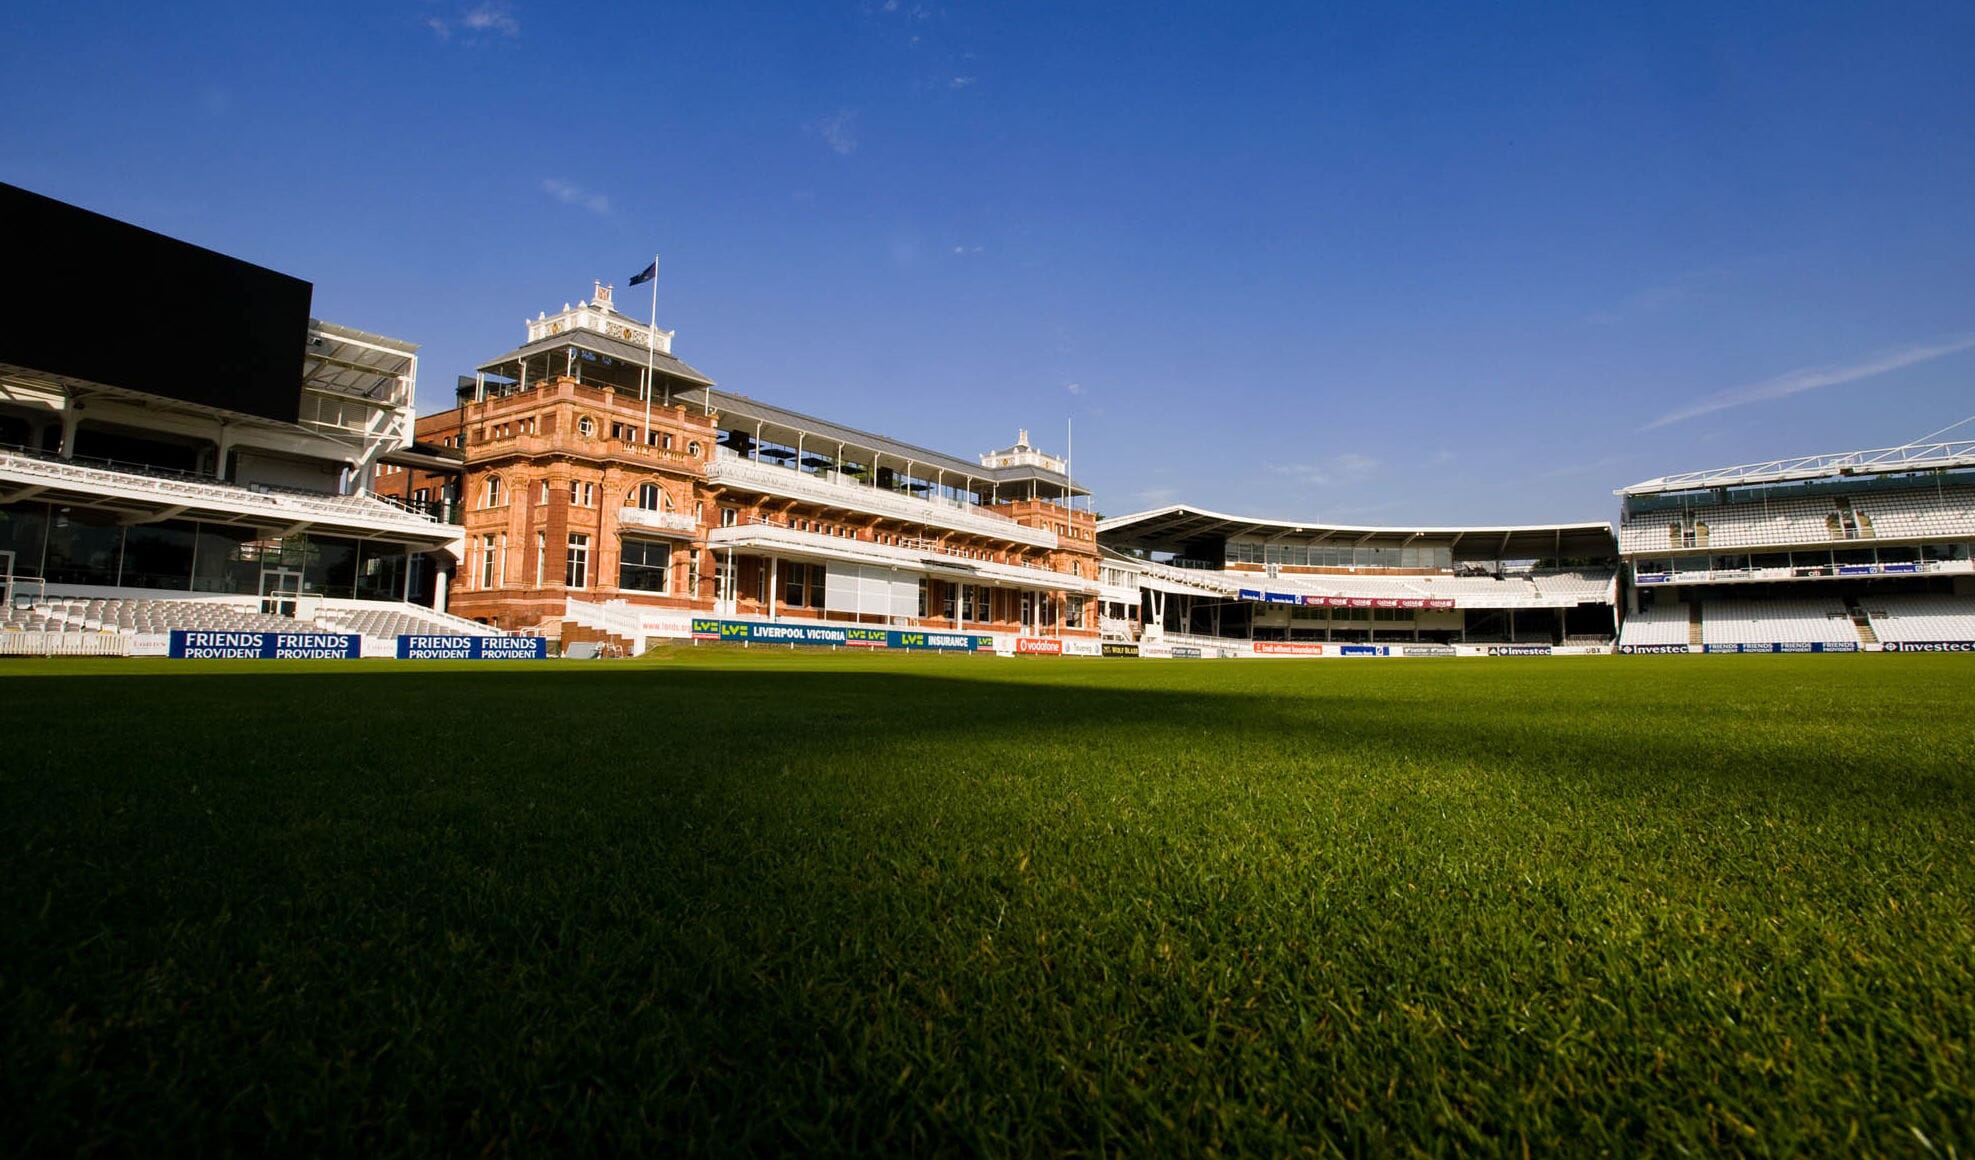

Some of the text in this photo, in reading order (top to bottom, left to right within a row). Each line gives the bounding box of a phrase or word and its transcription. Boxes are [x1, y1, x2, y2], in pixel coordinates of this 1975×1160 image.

[753, 626, 805, 639] LIVERPOOL
[806, 629, 845, 641] VICTORIA
[185, 633, 263, 647] FRIENDS
[276, 635, 349, 648] FRIENDS
[409, 637, 471, 649] FRIENDS
[481, 638, 537, 649] FRIENDS
[928, 635, 969, 647] INSURANCE
[1027, 641, 1060, 652] vodafone
[1508, 647, 1551, 655] Investec
[1633, 644, 1688, 654] Investec
[1900, 641, 1970, 652] Investec
[185, 648, 262, 659] PROVIDENT
[276, 649, 348, 659] PROVIDENT
[408, 650, 470, 659] PROVIDENT
[481, 650, 537, 659] PROVIDENT
